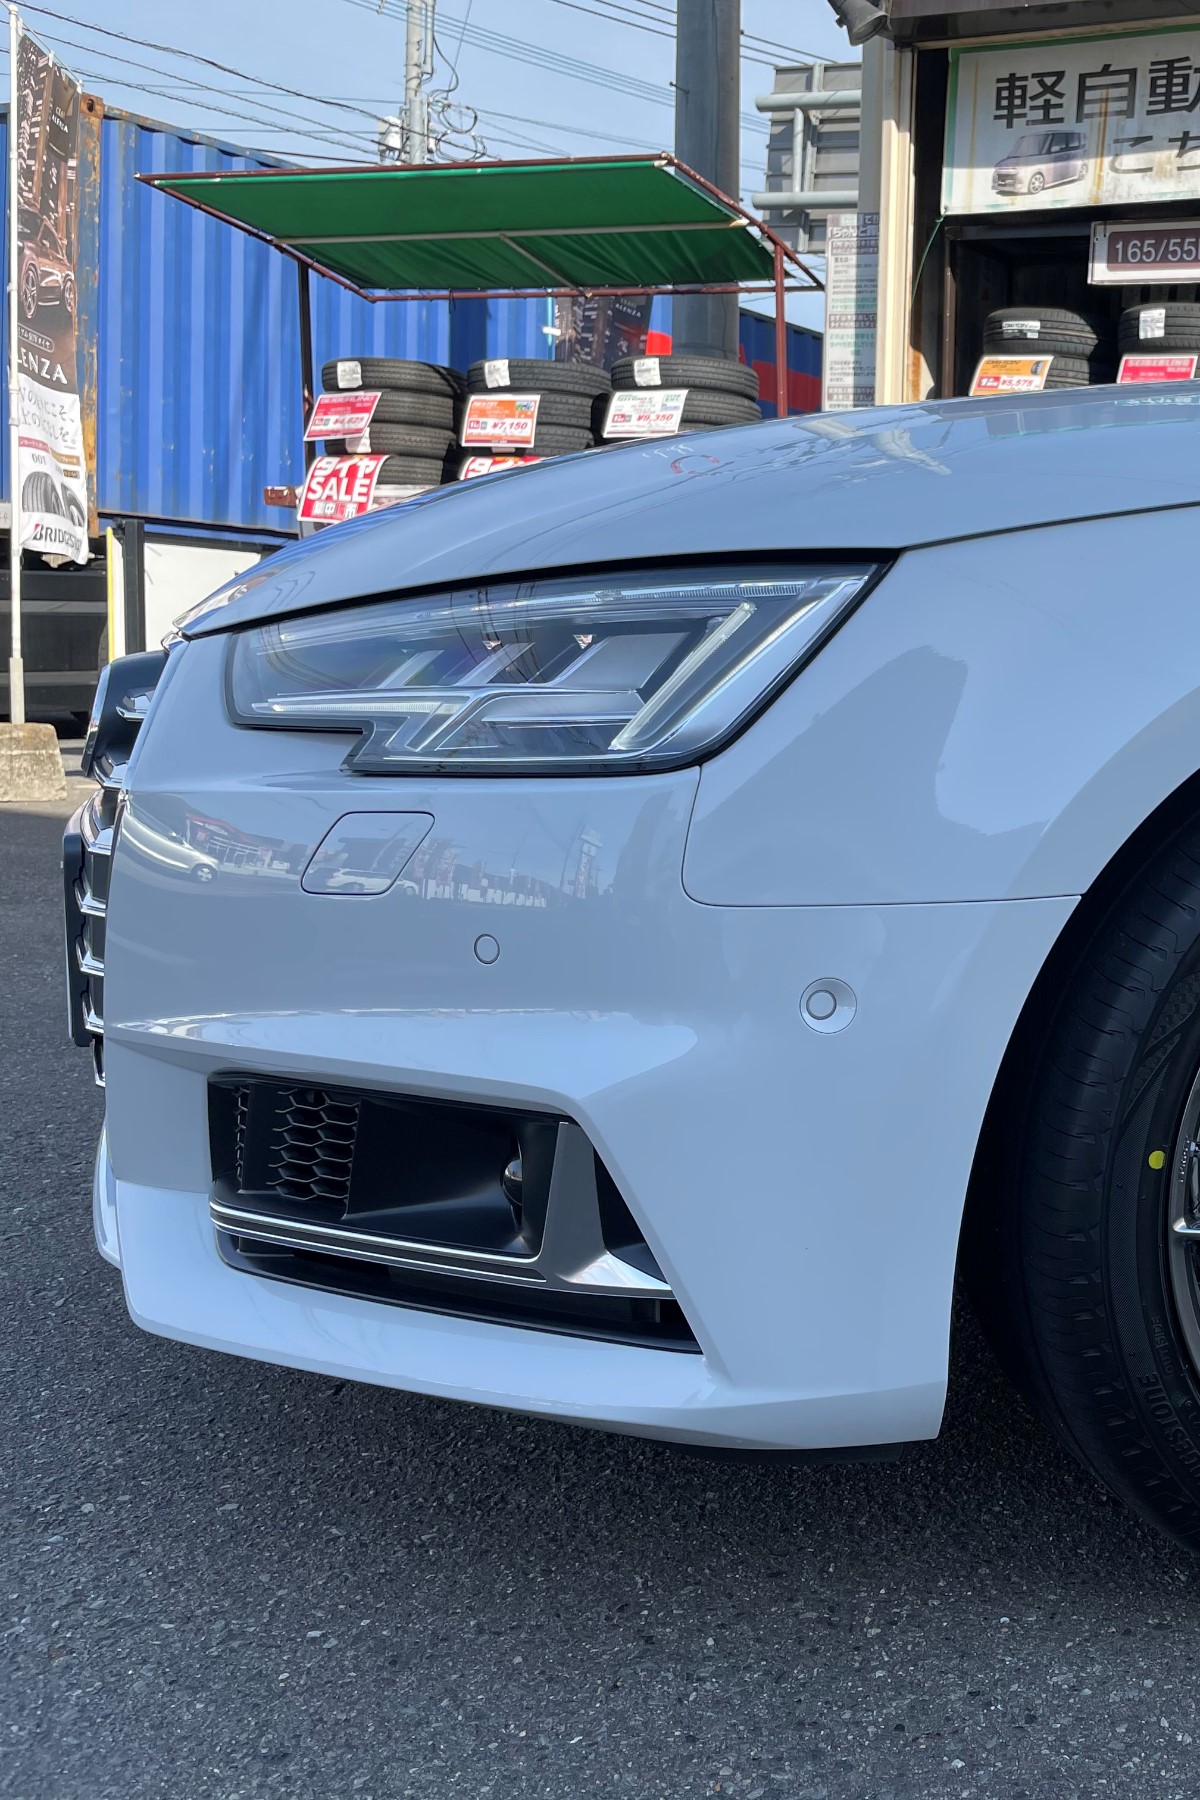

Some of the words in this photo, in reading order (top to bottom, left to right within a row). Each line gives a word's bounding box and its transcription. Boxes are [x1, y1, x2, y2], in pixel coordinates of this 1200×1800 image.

[492, 421, 528, 432] ¥7,150
[313, 457, 378, 479] タイヤ
[307, 476, 372, 502] SALE
